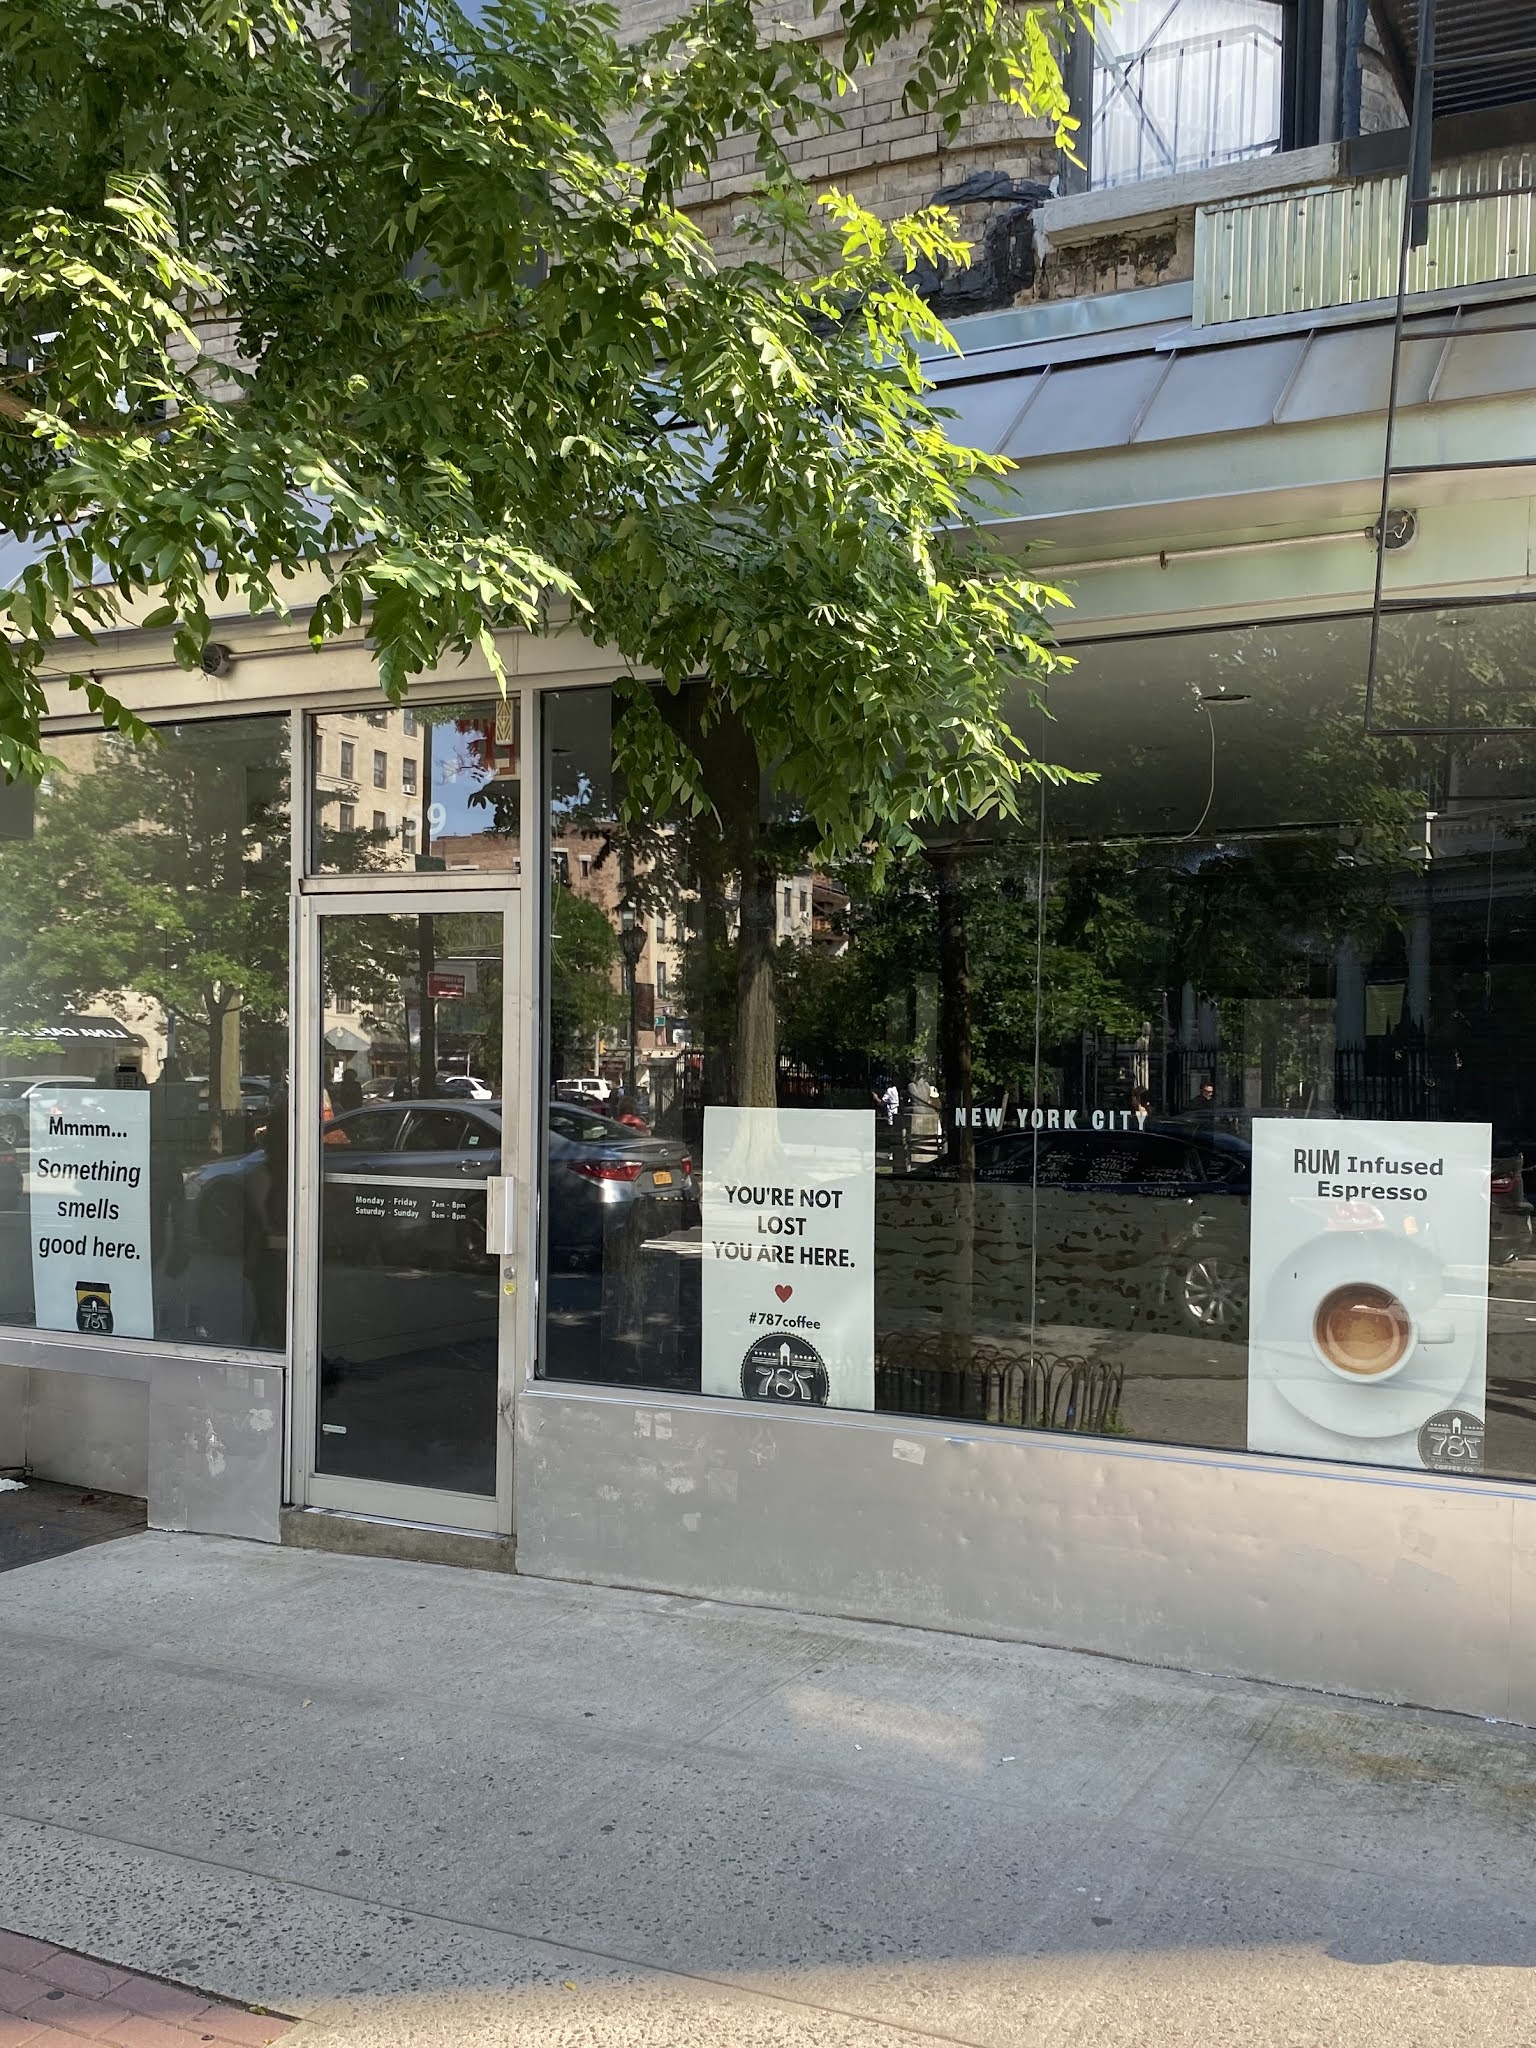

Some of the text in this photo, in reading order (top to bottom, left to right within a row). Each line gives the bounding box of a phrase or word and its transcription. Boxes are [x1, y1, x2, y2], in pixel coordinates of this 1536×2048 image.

[49, 1116, 128, 1138] Mmmm...
[955, 1107, 1148, 1130] NEW YORK CITY
[36, 1157, 141, 1188] Something
[1293, 1148, 1444, 1176] RUM Infused
[355, 1195, 385, 1206] Monday
[393, 1197, 418, 1208] Friday
[431, 1200, 445, 1208] 7am
[452, 1201, 466, 1210] 8pm
[724, 1185, 843, 1209] YOU'RE NOT
[1317, 1180, 1428, 1202] Espresso
[57, 1198, 120, 1221] smells
[355, 1206, 386, 1217] Saturday
[393, 1208, 419, 1219] Sunday
[431, 1211, 445, 1219] 8am
[452, 1212, 466, 1220] 8pm
[757, 1215, 807, 1236] LOST
[39, 1234, 141, 1260] good here.
[711, 1240, 856, 1268] YOU ARE HERE.
[749, 1312, 821, 1330] #787coffee
[755, 1366, 814, 1400] 787
[1430, 1435, 1481, 1459] 787
[1434, 1464, 1462, 1472] COFFEE
